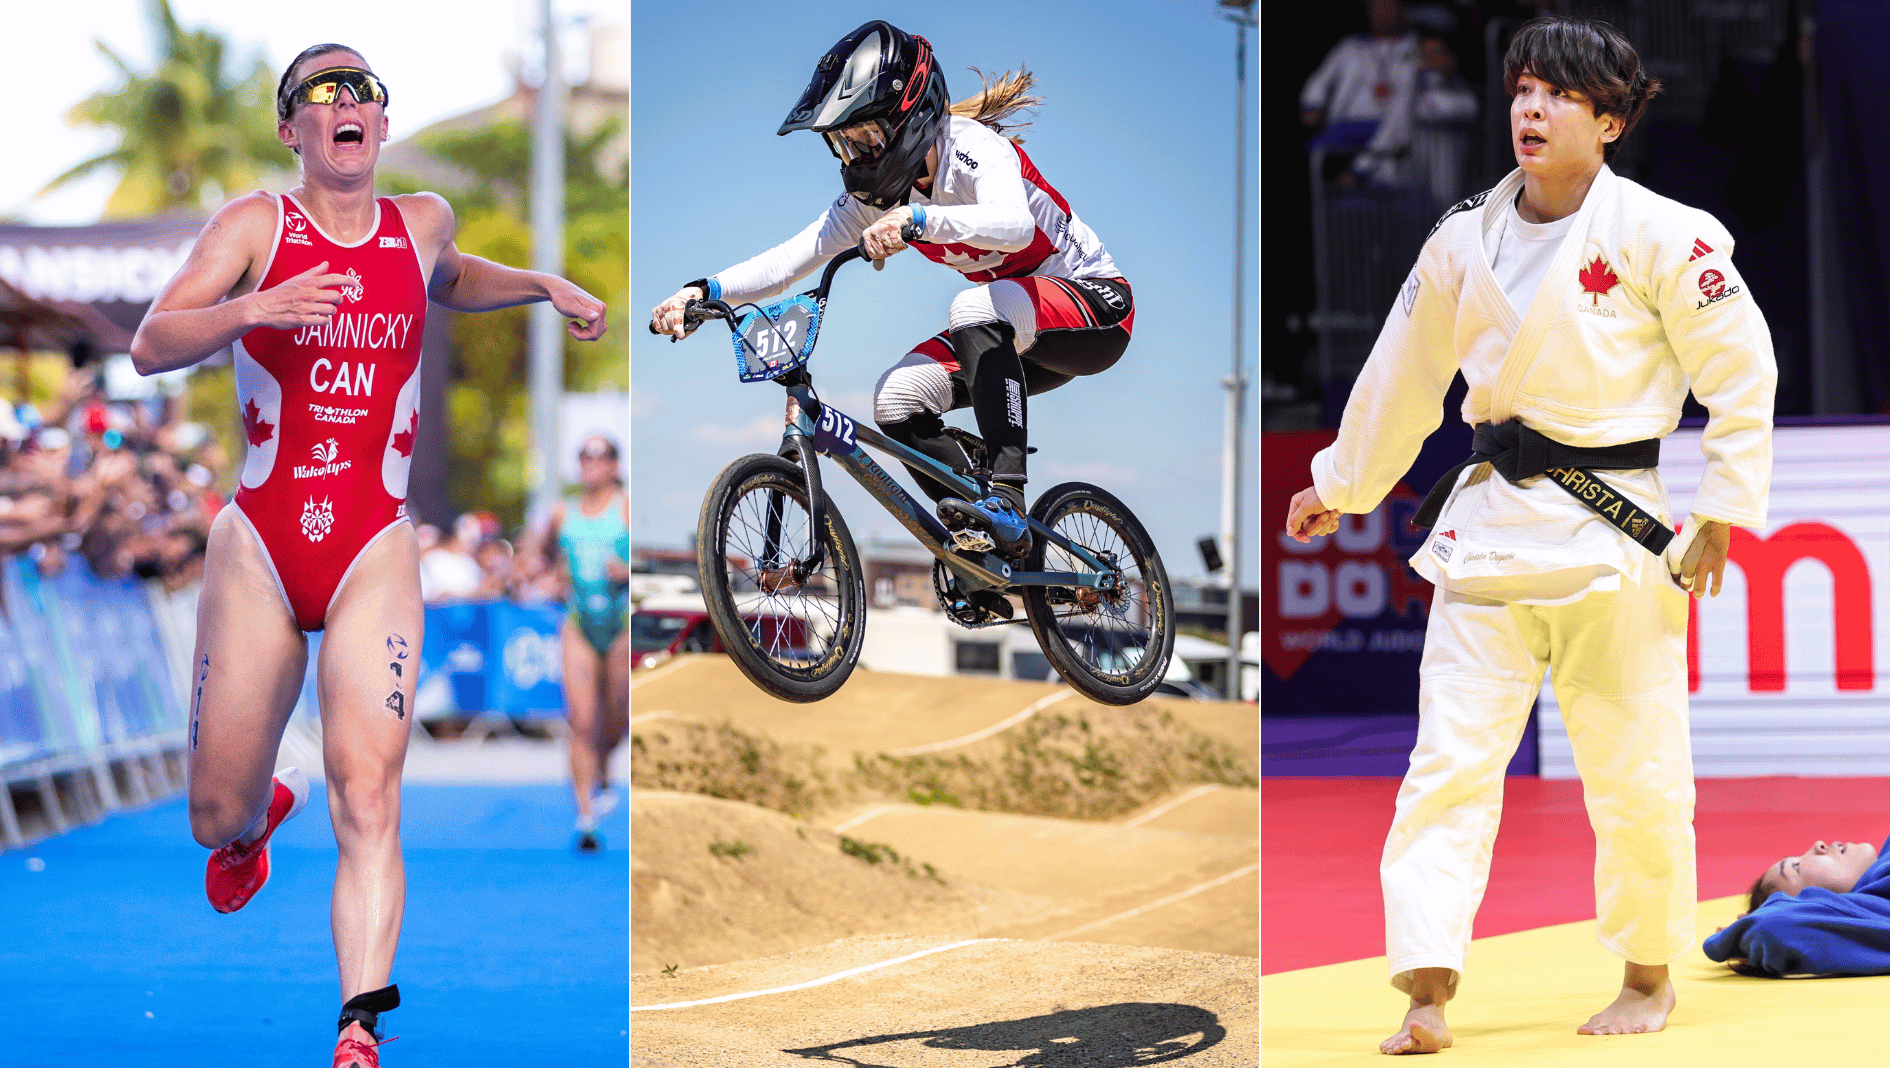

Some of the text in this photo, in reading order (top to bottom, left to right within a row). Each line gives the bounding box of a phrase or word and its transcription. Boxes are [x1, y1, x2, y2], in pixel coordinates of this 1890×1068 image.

[955, 149, 979, 170] wahoo
[285, 236, 313, 246] Triathlon
[288, 231, 308, 240] World
[1577, 304, 1617, 319] CANADA
[294, 312, 414, 350] JAMNICKY
[756, 319, 798, 359] 512
[310, 357, 377, 397] CAN
[314, 413, 356, 424] CANADA
[821, 405, 854, 446] 512
[1632, 516, 1649, 538] adidas
